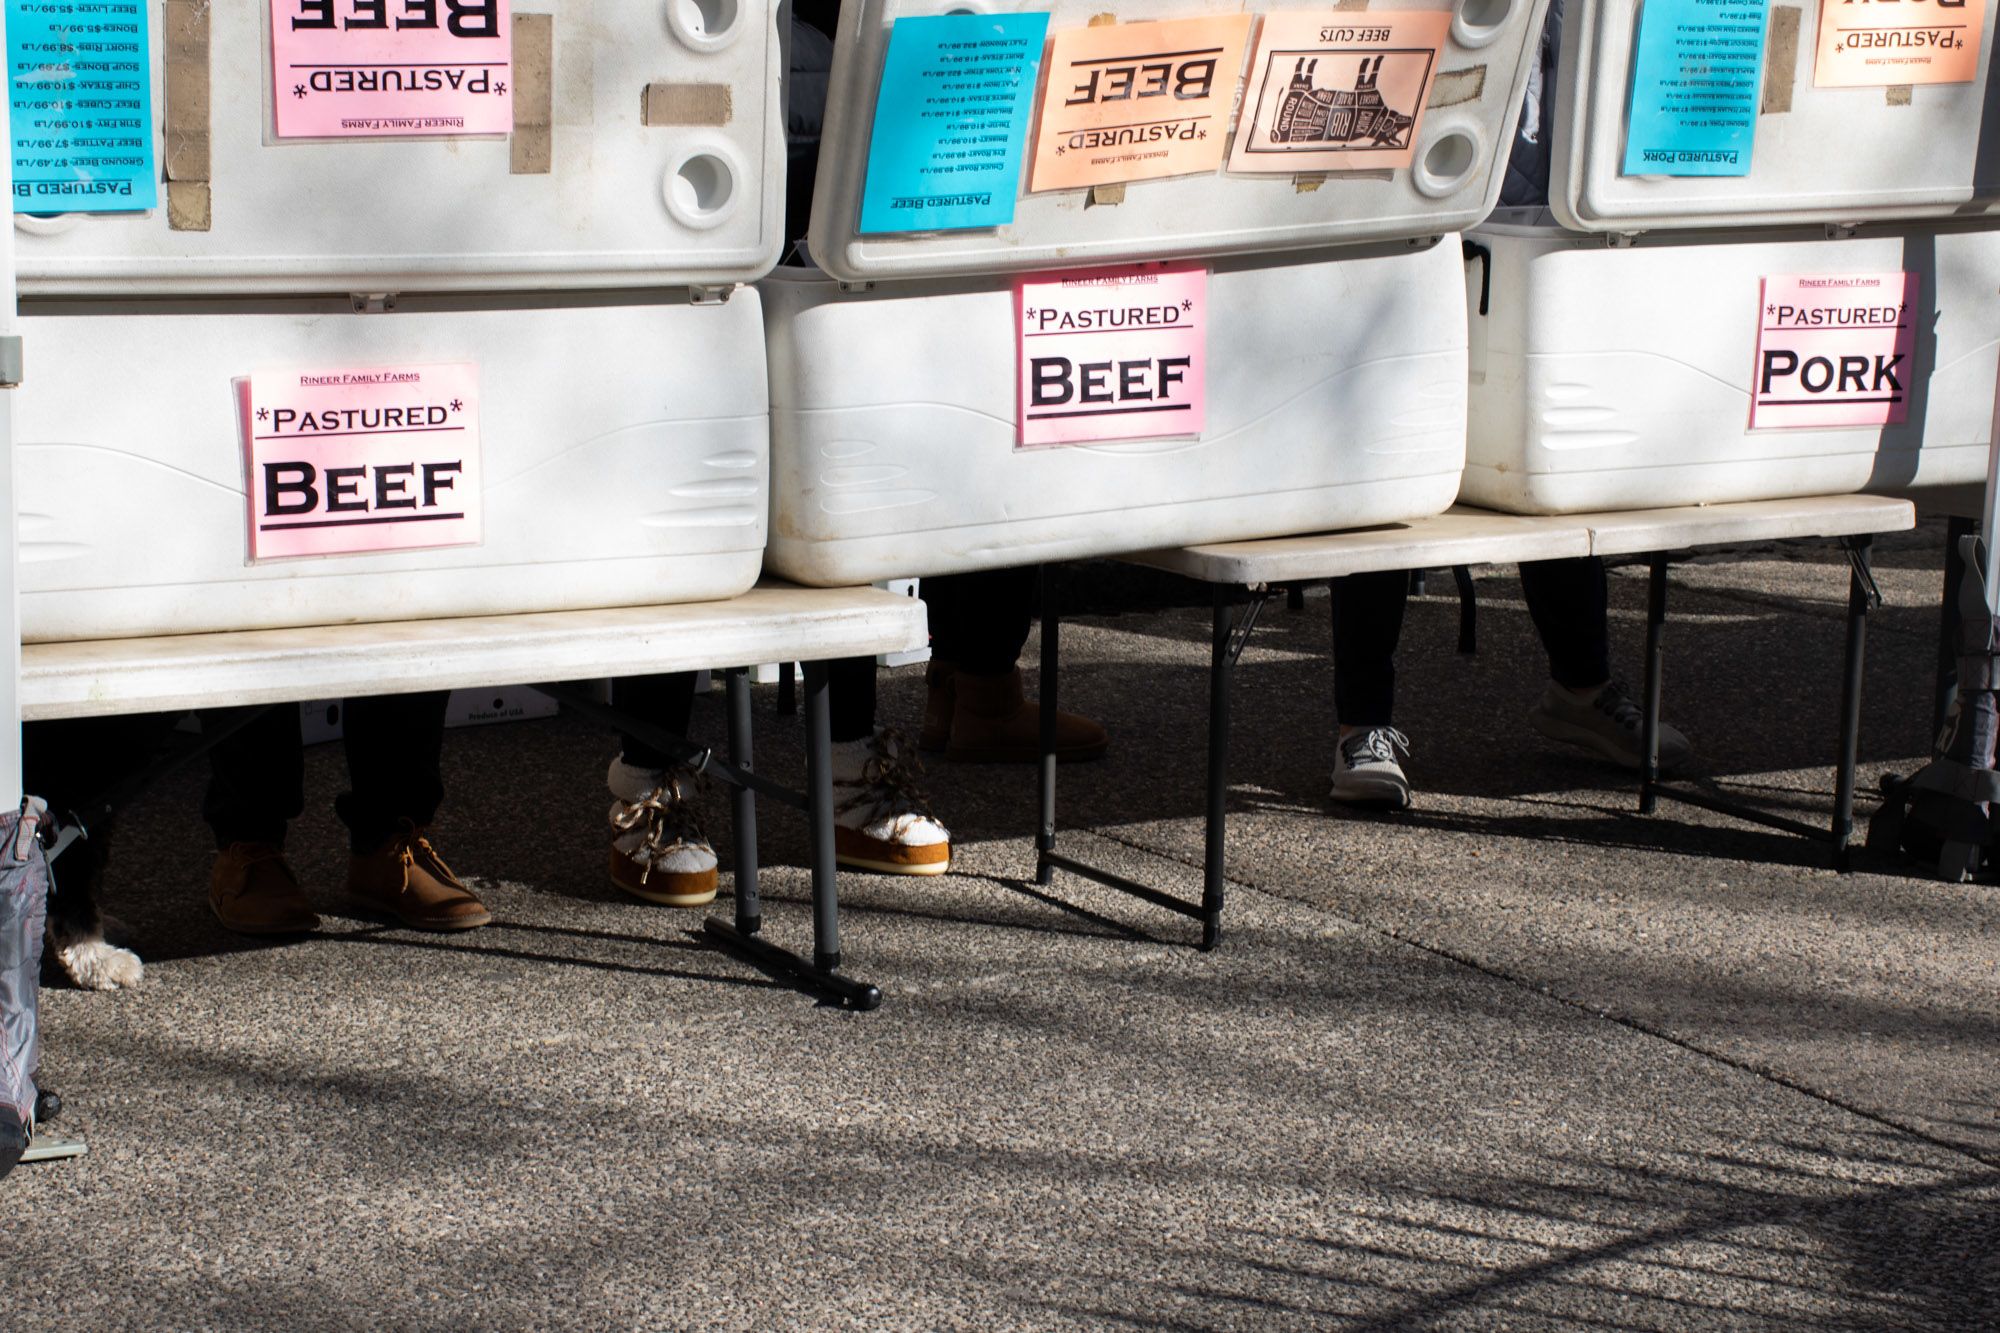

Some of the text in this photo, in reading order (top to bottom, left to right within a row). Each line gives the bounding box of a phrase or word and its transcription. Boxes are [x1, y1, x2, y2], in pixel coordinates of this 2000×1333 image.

[21, 4, 74, 14] $5.99/LB
[111, 6, 137, 14] BEEF
[1319, 30, 1390, 42] BEEF CUTS
[107, 44, 139, 52] SHORT
[112, 63, 140, 72] SOUP
[16, 82, 76, 90] $10.99/LB
[116, 82, 140, 90] CHIP
[1064, 58, 1218, 108] BEEF
[14, 101, 72, 109] $10.99/LB
[118, 101, 140, 109] BEEF
[1280, 98, 1298, 132] ROUND
[34, 120, 92, 128] $10.99/LB
[120, 120, 142, 128] STIR
[341, 120, 464, 130] RINEER FAMILY FARMS
[1331, 112, 1351, 137] RIB
[18, 140, 68, 148] $7.99/LB
[118, 140, 142, 148] BEEF
[102, 158, 144, 166] GROUND
[1090, 157, 1116, 165] FARMS
[1117, 154, 1142, 162] FAMILY
[1643, 152, 1738, 164] PASTURED PORK
[16, 159, 68, 167] $7.49/LB
[37, 182, 132, 196] PASTURED
[890, 196, 990, 210] PASTURED BEEF
[1096, 276, 1128, 286] FAMILY
[1129, 274, 1158, 284] FARMS
[1799, 278, 1880, 287] RINEER FAMILY FARMS
[1758, 350, 1905, 394] PORK
[300, 372, 421, 384] RINEER FAMILY FARMS
[1030, 355, 1191, 407] BEEF
[262, 460, 463, 517] BEEF
[468, 708, 524, 720] Produce of USA
